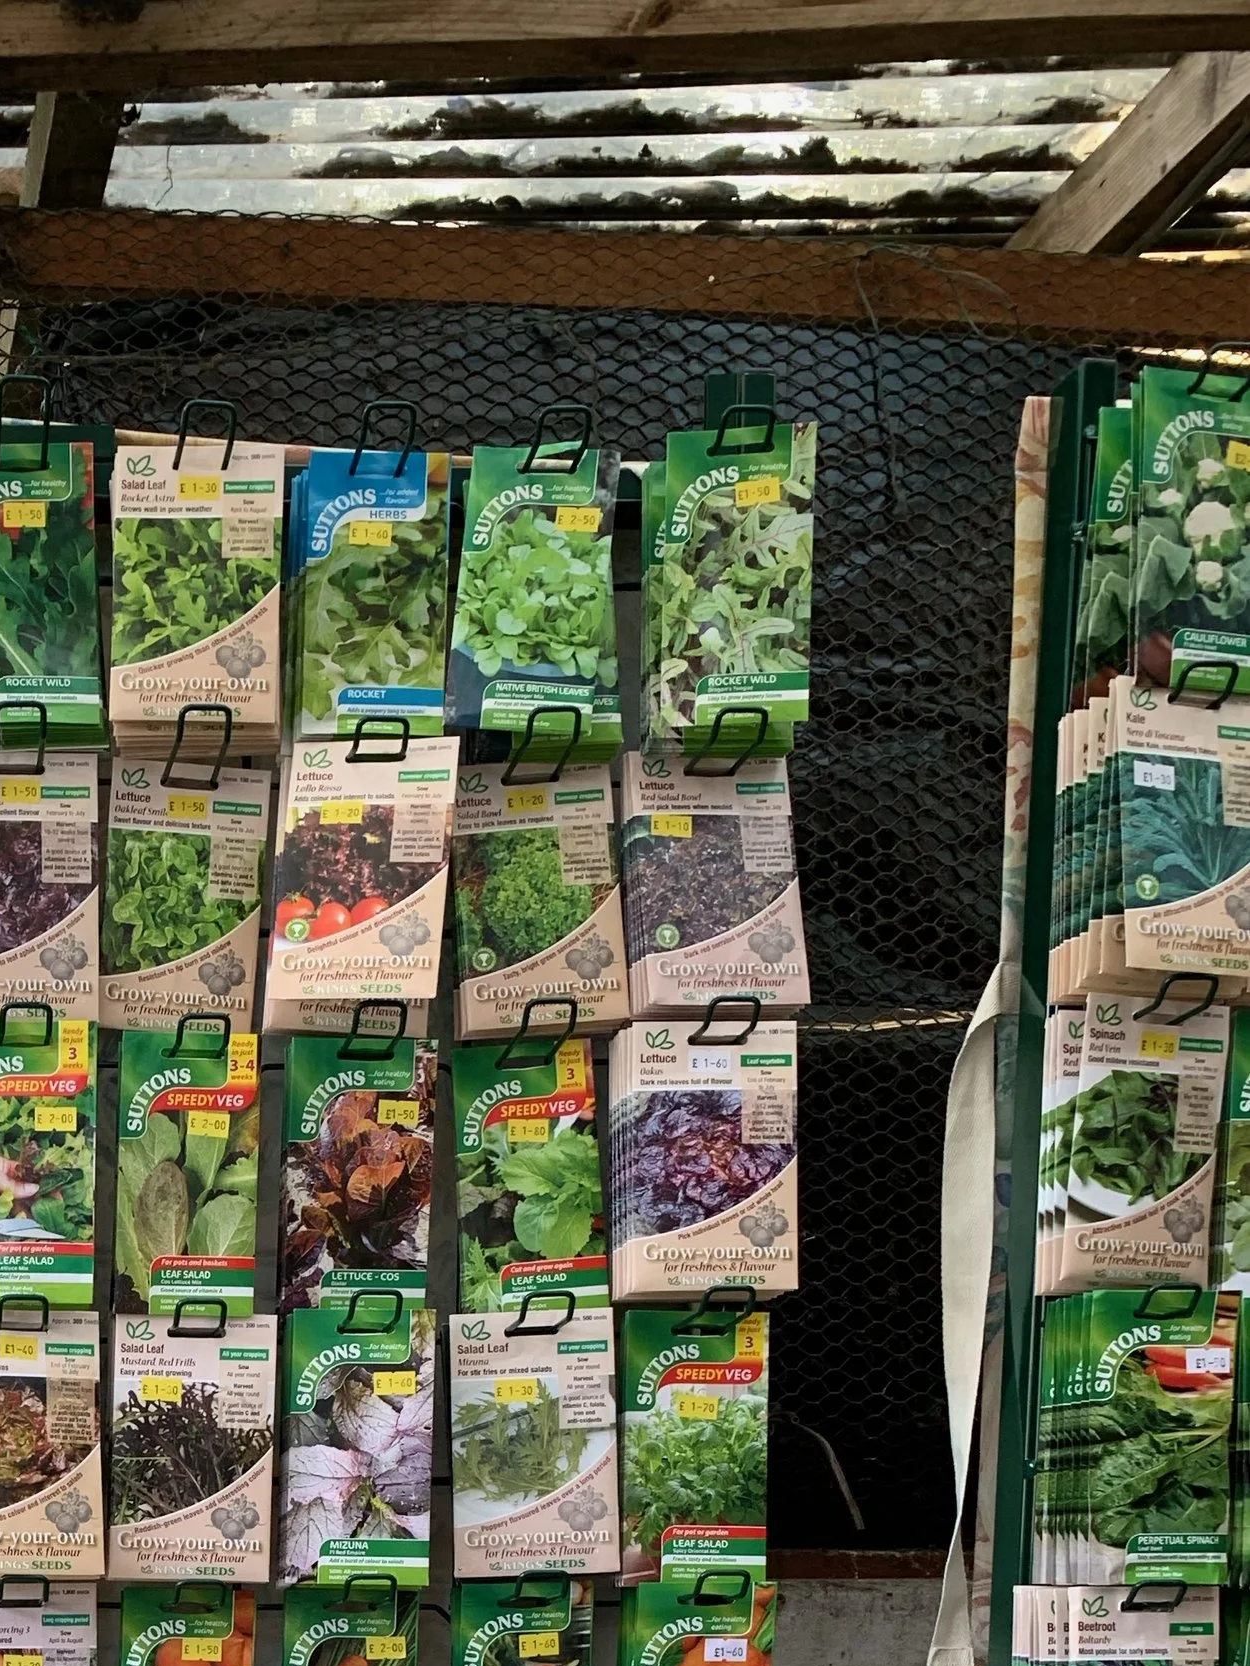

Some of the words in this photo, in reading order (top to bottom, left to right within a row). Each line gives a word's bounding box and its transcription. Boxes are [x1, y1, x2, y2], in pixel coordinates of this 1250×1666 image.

[311, 488, 376, 551] SUTTONS
[369, 509, 408, 521] HERBS
[1184, 631, 1247, 648] CAULIFLOWER
[6, 678, 42, 687] ROCKET
[45, 678, 70, 687] WILD
[347, 689, 386, 699] ROCKET
[496, 681, 524, 692] NATIVE
[526, 684, 558, 695] BRITISH
[560, 687, 589, 697] LEAVES
[1126, 713, 1145, 724] Kale
[296, 771, 333, 782] Lettuce
[295, 784, 315, 793] Lollo
[318, 783, 342, 792] Rossa
[1090, 1028, 1125, 1041] Spinach
[511, 1273, 534, 1284] LEAF
[537, 1272, 566, 1282] SALAD
[457, 1344, 483, 1353] Salad
[485, 1342, 509, 1352] Leaf
[1095, 1326, 1160, 1393] SUTTONS
[330, 1541, 368, 1550] MIZUNA
[1138, 1536, 1179, 1545] PERPETUAL
[1182, 1536, 1218, 1545] SPINACH
[1078, 1621, 1116, 1633] Beetroot
[1078, 1635, 1111, 1646] Boltardy
